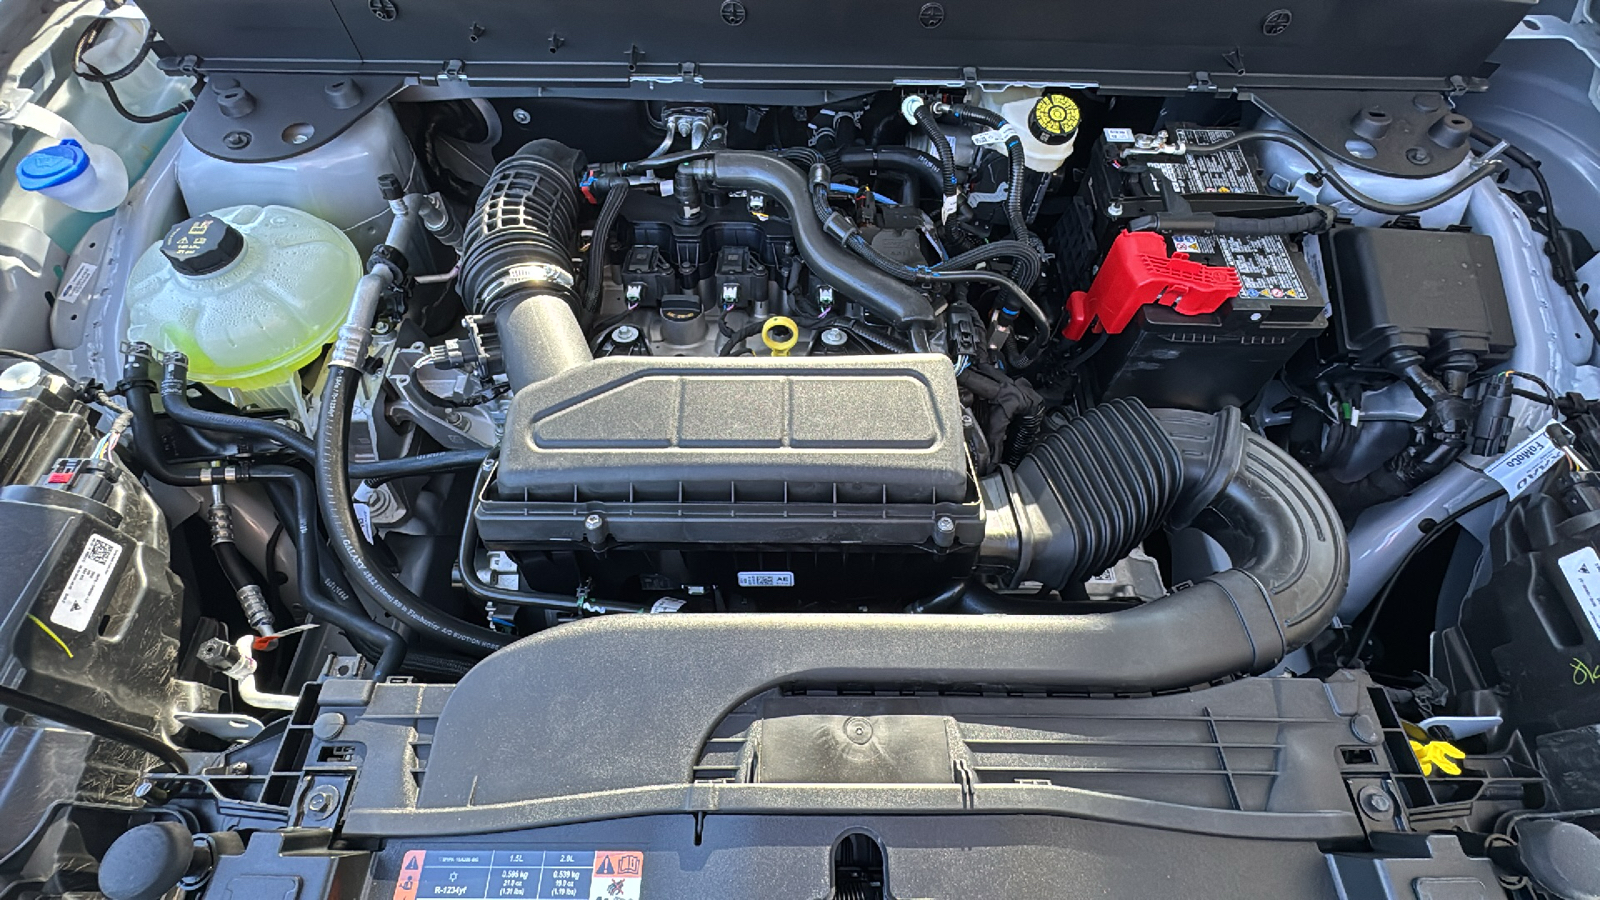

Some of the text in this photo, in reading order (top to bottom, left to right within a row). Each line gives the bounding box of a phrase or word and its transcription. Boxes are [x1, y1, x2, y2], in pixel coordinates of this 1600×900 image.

[1506, 441, 1545, 468] FoMoCo
[342, 539, 367, 570] GALAXY
[510, 854, 524, 862] 1.5L
[520, 870, 528, 880] kg
[572, 870, 580, 880] kg
[434, 886, 468, 896] R-1234yf
